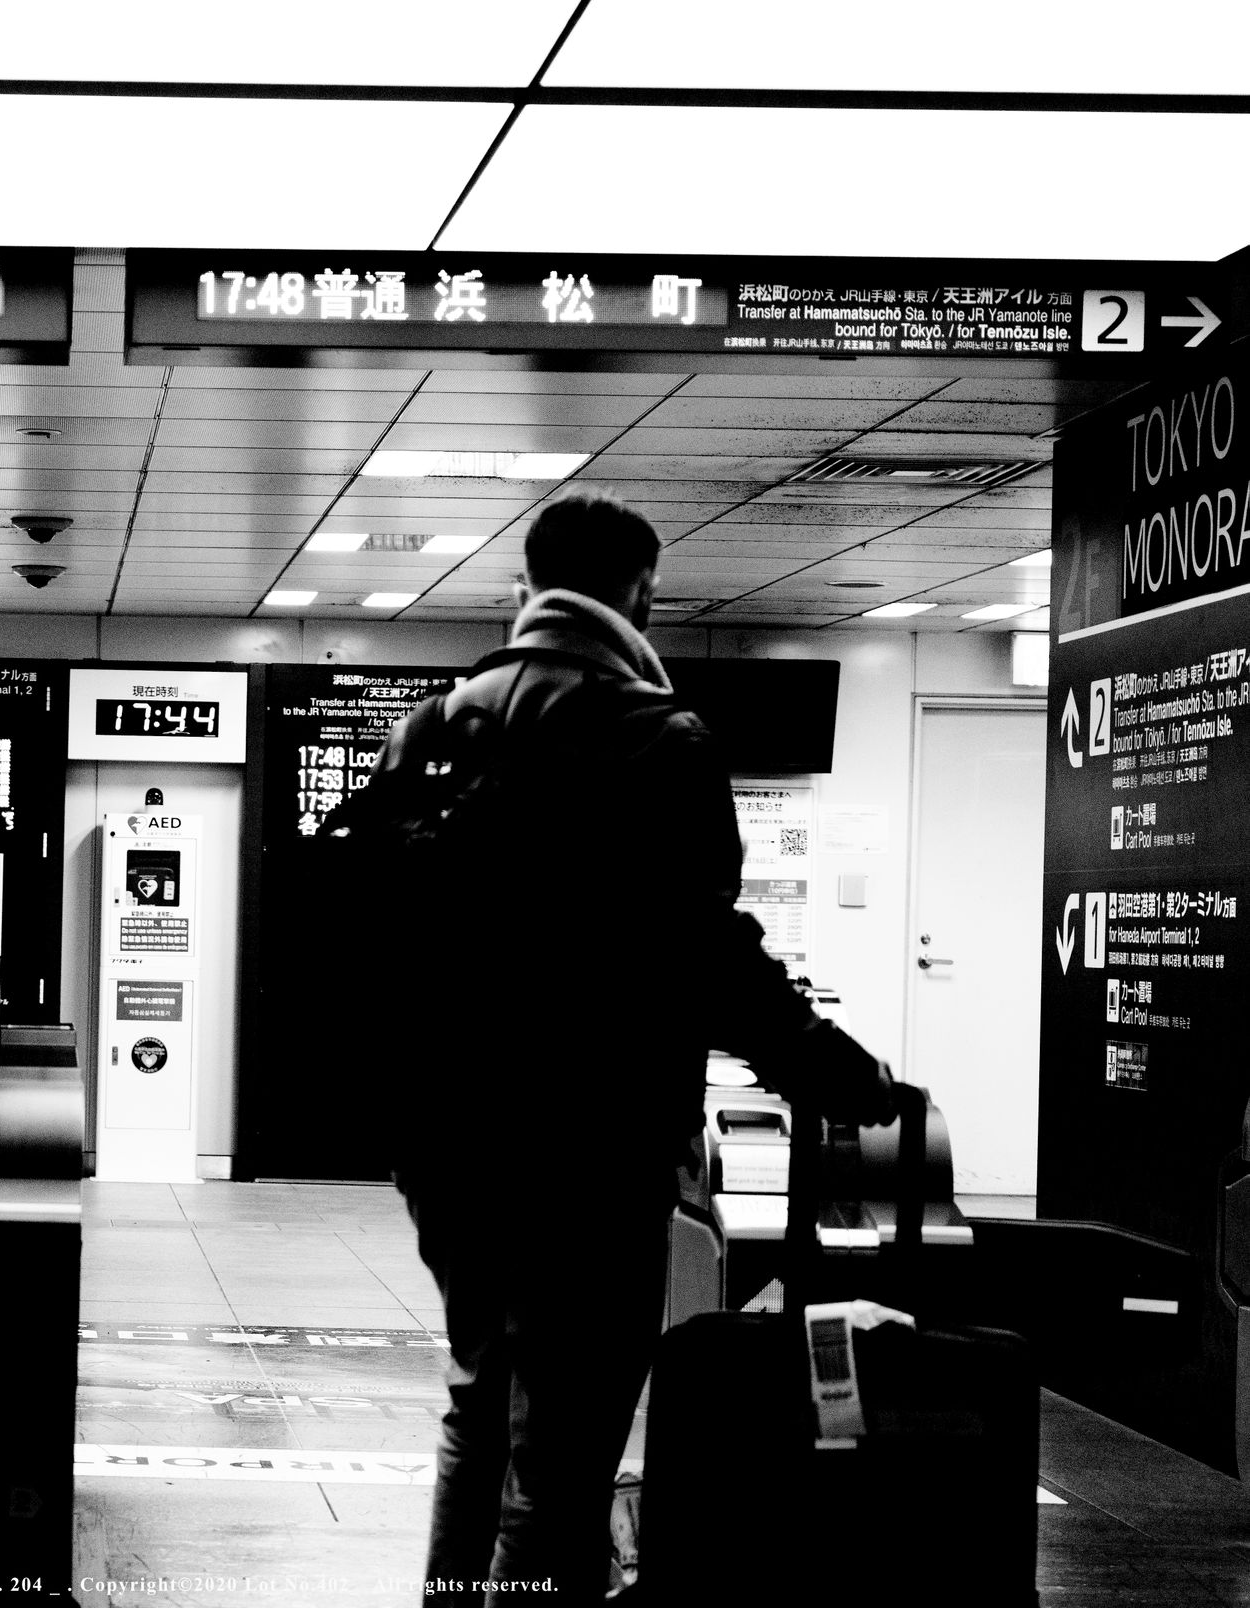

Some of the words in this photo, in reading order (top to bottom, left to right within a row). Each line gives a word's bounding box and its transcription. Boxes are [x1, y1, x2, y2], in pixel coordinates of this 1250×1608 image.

[200, 270, 305, 316] 17:48
[312, 268, 409, 322] 普通
[739, 284, 837, 302] 浜松町のりかえ
[943, 287, 1043, 305] 天王洲アイル
[1048, 293, 1072, 306] 方面
[737, 303, 786, 320] Transfer
[789, 307, 801, 320] at
[804, 305, 901, 321] Hamamatsuchō
[905, 306, 928, 321] Sta.
[932, 308, 944, 322] to
[946, 307, 965, 322] the
[968, 308, 984, 322] JR
[988, 308, 1048, 323] Yamanote
[1051, 309, 1072, 323] line
[1097, 295, 1128, 345] 2
[835, 321, 877, 337] bound
[880, 322, 898, 337] for
[958, 324, 975, 339] for
[978, 324, 1039, 340] Tennōzu
[1043, 325, 1072, 340] Isle.
[1126, 375, 1235, 492] TOKYO
[26, 686, 33, 695] 2
[333, 674, 392, 686] 浜松町のりかえ
[132, 686, 179, 698] 現在時刻
[310, 698, 346, 707] Transfer
[348, 699, 356, 707] at
[283, 707, 292, 716] to
[293, 707, 306, 716] the
[307, 708, 319, 716] JR
[321, 708, 363, 717] Yamanote
[363, 708, 378, 717] line
[380, 709, 406, 717] bound
[1114, 703, 1140, 728] Transfer
[1140, 704, 1147, 723] at
[1147, 692, 1201, 722] Hamamatsuchō
[1202, 690, 1216, 712] Sta.
[1217, 689, 1225, 709] to
[1226, 685, 1238, 708] the
[1239, 682, 1249, 706] JR
[114, 703, 216, 733] 17:44
[373, 718, 385, 727] for
[1094, 687, 1106, 747] 2
[1113, 731, 1133, 753] bound
[1134, 730, 1143, 750] for
[1172, 725, 1182, 744] for
[1183, 718, 1215, 742] Tennōzu
[1217, 713, 1234, 737] Isle.
[298, 745, 346, 767] 17:48
[148, 817, 182, 829] AED
[1125, 802, 1157, 826] カート置場
[1125, 831, 1138, 849] Cart
[1138, 830, 1152, 848] Pool
[1109, 926, 1117, 942] for
[1118, 927, 1139, 943] Haneda
[1140, 927, 1161, 948] Airport
[1161, 927, 1187, 944] Terminal
[1194, 927, 1200, 944] 2
[1121, 980, 1152, 1004] カート置場
[1121, 1006, 1134, 1025] Cart
[1134, 1007, 1148, 1026] Pool
[173, 1391, 373, 1409] SPA
